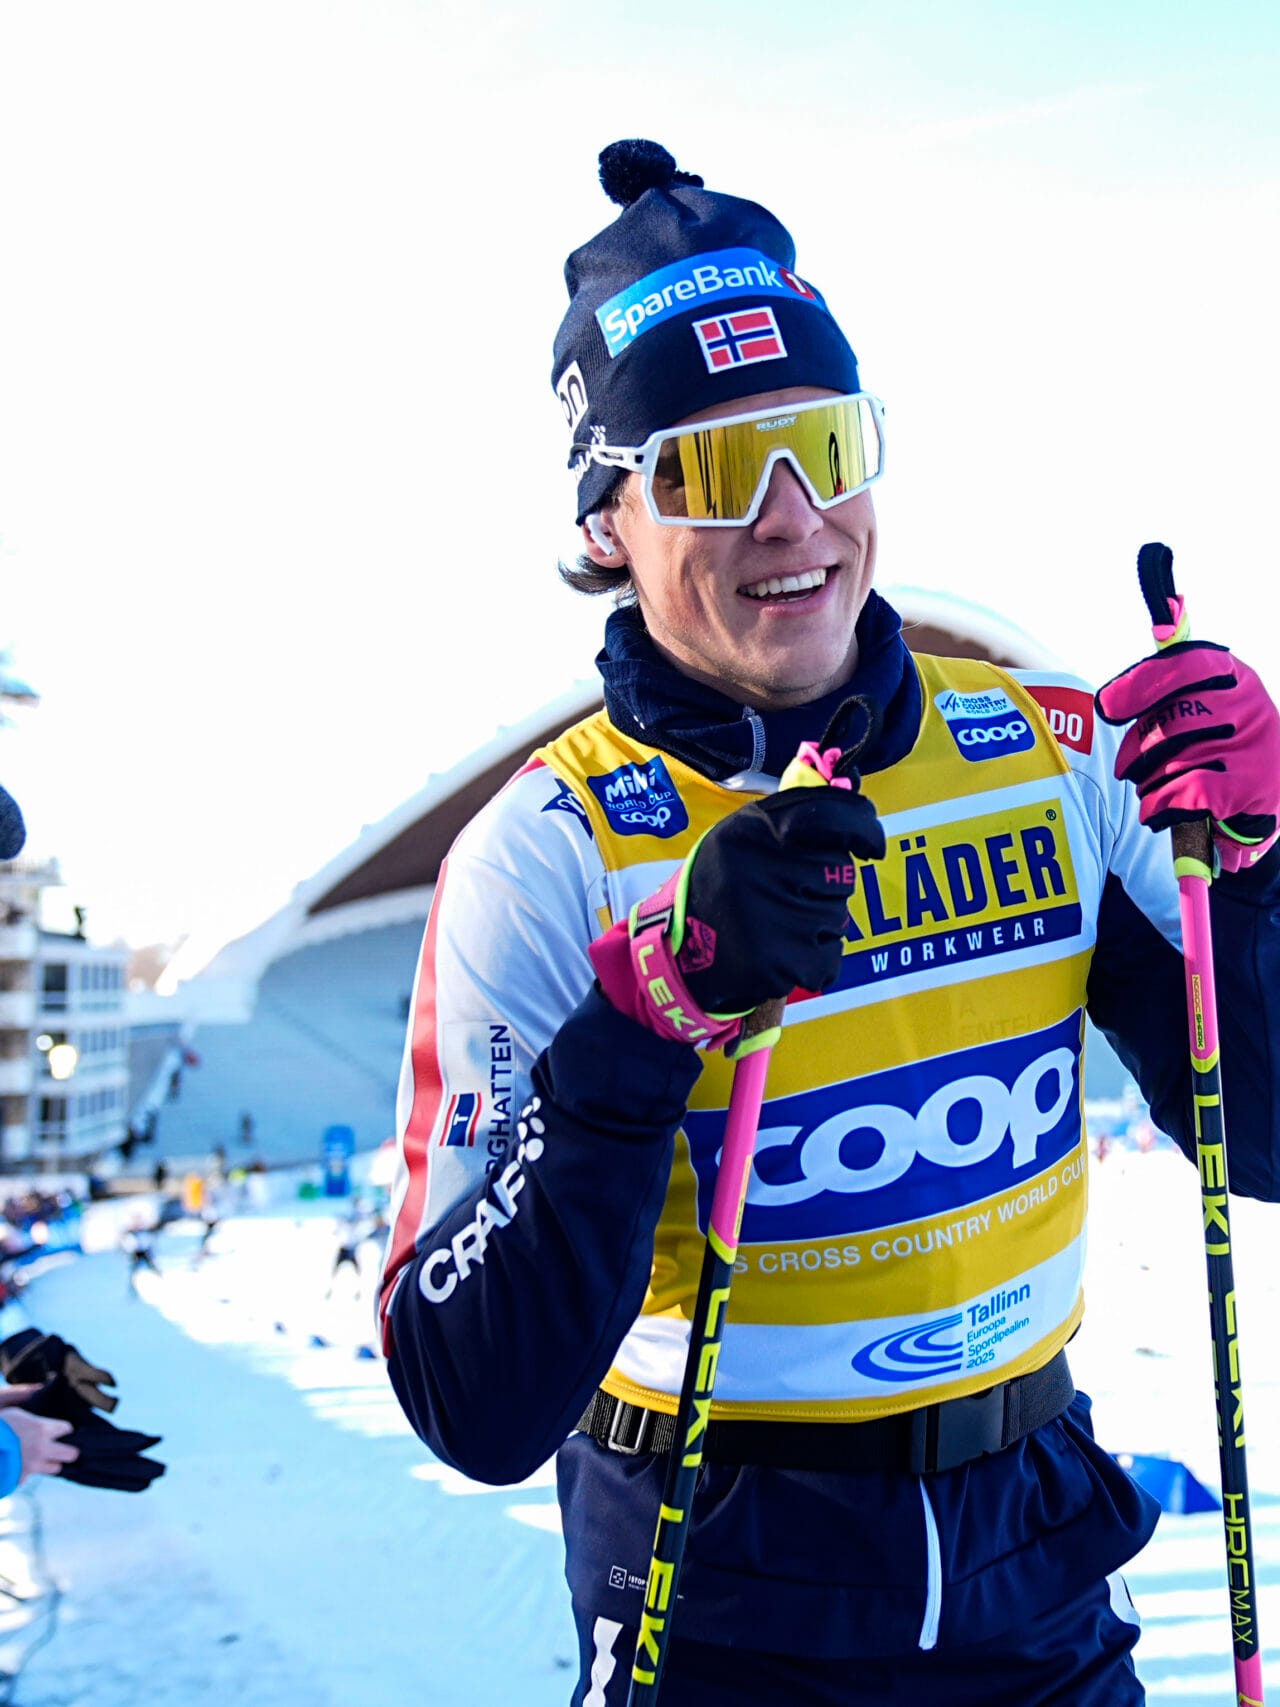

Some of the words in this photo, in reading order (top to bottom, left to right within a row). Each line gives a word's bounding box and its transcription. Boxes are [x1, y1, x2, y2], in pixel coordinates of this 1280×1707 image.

[604, 261, 783, 344] SpareBank
[786, 272, 806, 294] 1
[756, 416, 797, 430] RUDY
[957, 720, 1027, 746] coop
[1040, 706, 1084, 742] DO
[605, 799, 647, 810] WORLD
[649, 791, 672, 805] CUP
[620, 807, 671, 829] coop
[824, 865, 855, 884] HE
[871, 917, 1045, 973] WORKWEAR
[638, 943, 708, 1038] LEKI
[715, 1046, 1075, 1207] coop
[1194, 1094, 1230, 1255] LEKI
[418, 1143, 526, 1303] CRAF
[759, 1245, 861, 1275] CROSS
[870, 1210, 992, 1261] COUNTRY
[997, 1176, 1058, 1224] WORLD
[966, 1283, 1031, 1327] Tallinn
[967, 1316, 1006, 1343] Euroopa
[968, 1317, 1030, 1357] Spordipealinn
[681, 1286, 731, 1468] LEKI
[966, 1348, 995, 1368] 2025
[631, 1502, 685, 1686] LEKI
